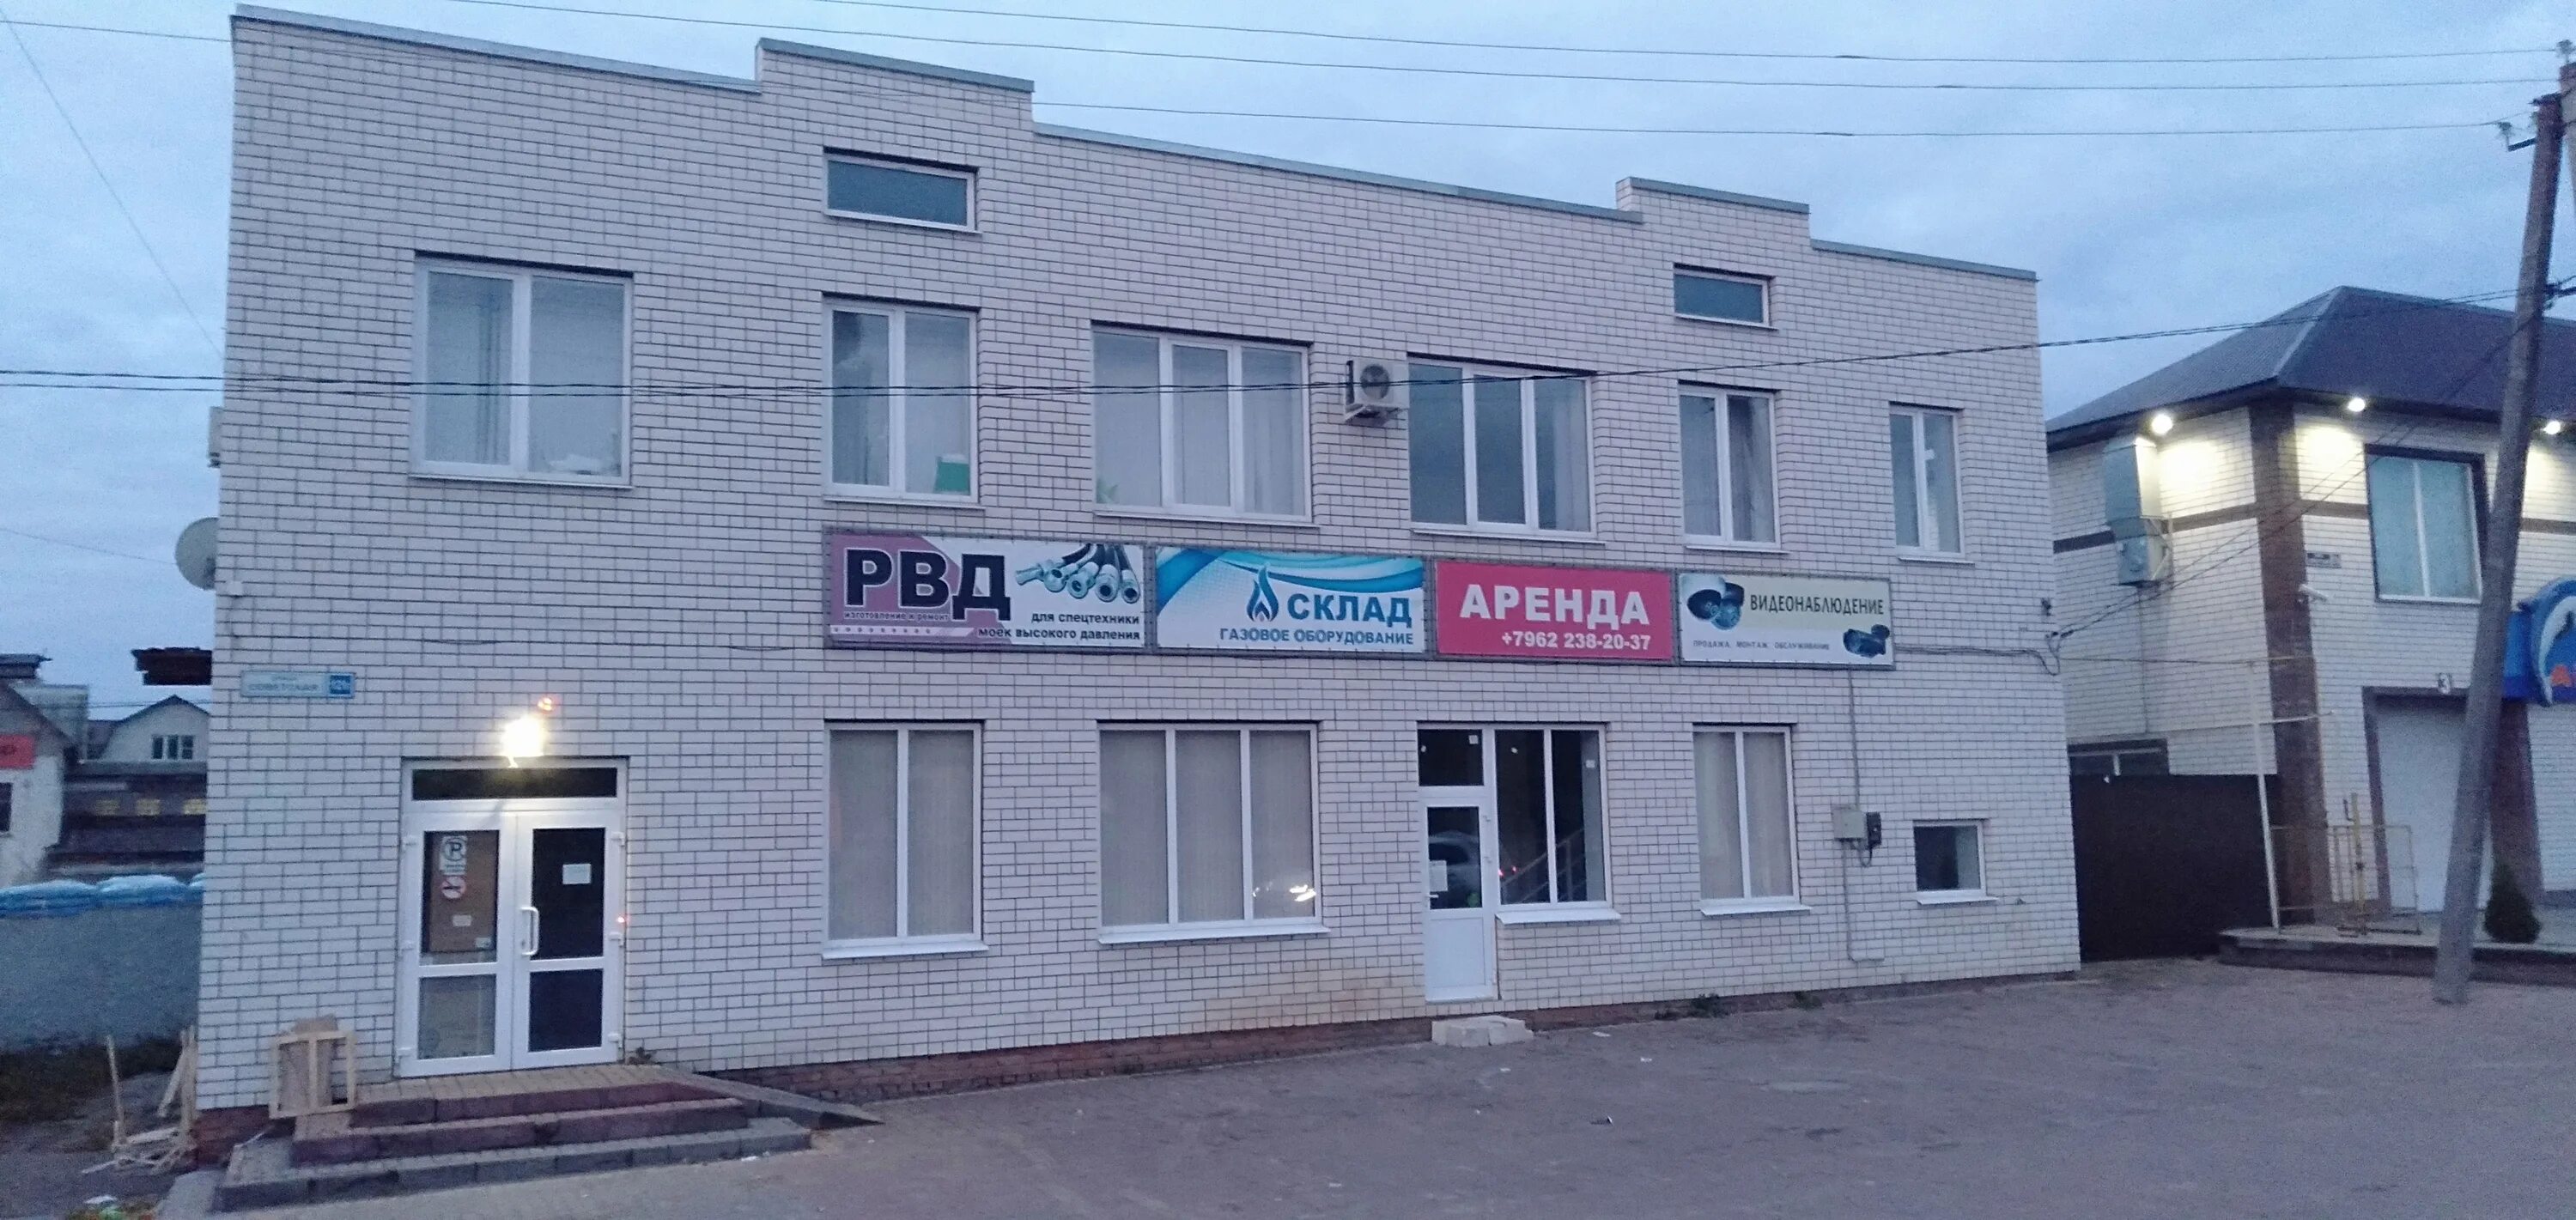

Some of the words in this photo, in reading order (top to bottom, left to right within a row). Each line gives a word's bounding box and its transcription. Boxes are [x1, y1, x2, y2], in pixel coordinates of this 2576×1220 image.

[845, 548, 1011, 621] РВД
[1287, 592, 1413, 628] СКЛАД
[1460, 584, 1649, 631] АРЕНДА
[1750, 594, 1885, 616] ВИДЕОНАБЛЮДЕНИЕ
[1031, 612, 1054, 622] для
[1058, 614, 1139, 625] спецтехники
[978, 628, 1012, 637] моек
[1016, 629, 1077, 639] высокого
[1080, 631, 1140, 640] давления
[1219, 628, 1290, 641] ГАЗОВОЕ
[1294, 630, 1413, 645] ОБОРУДОВАНИЕ
[1502, 631, 1558, 647] +7962
[1564, 633, 1651, 650] 238-20-37
